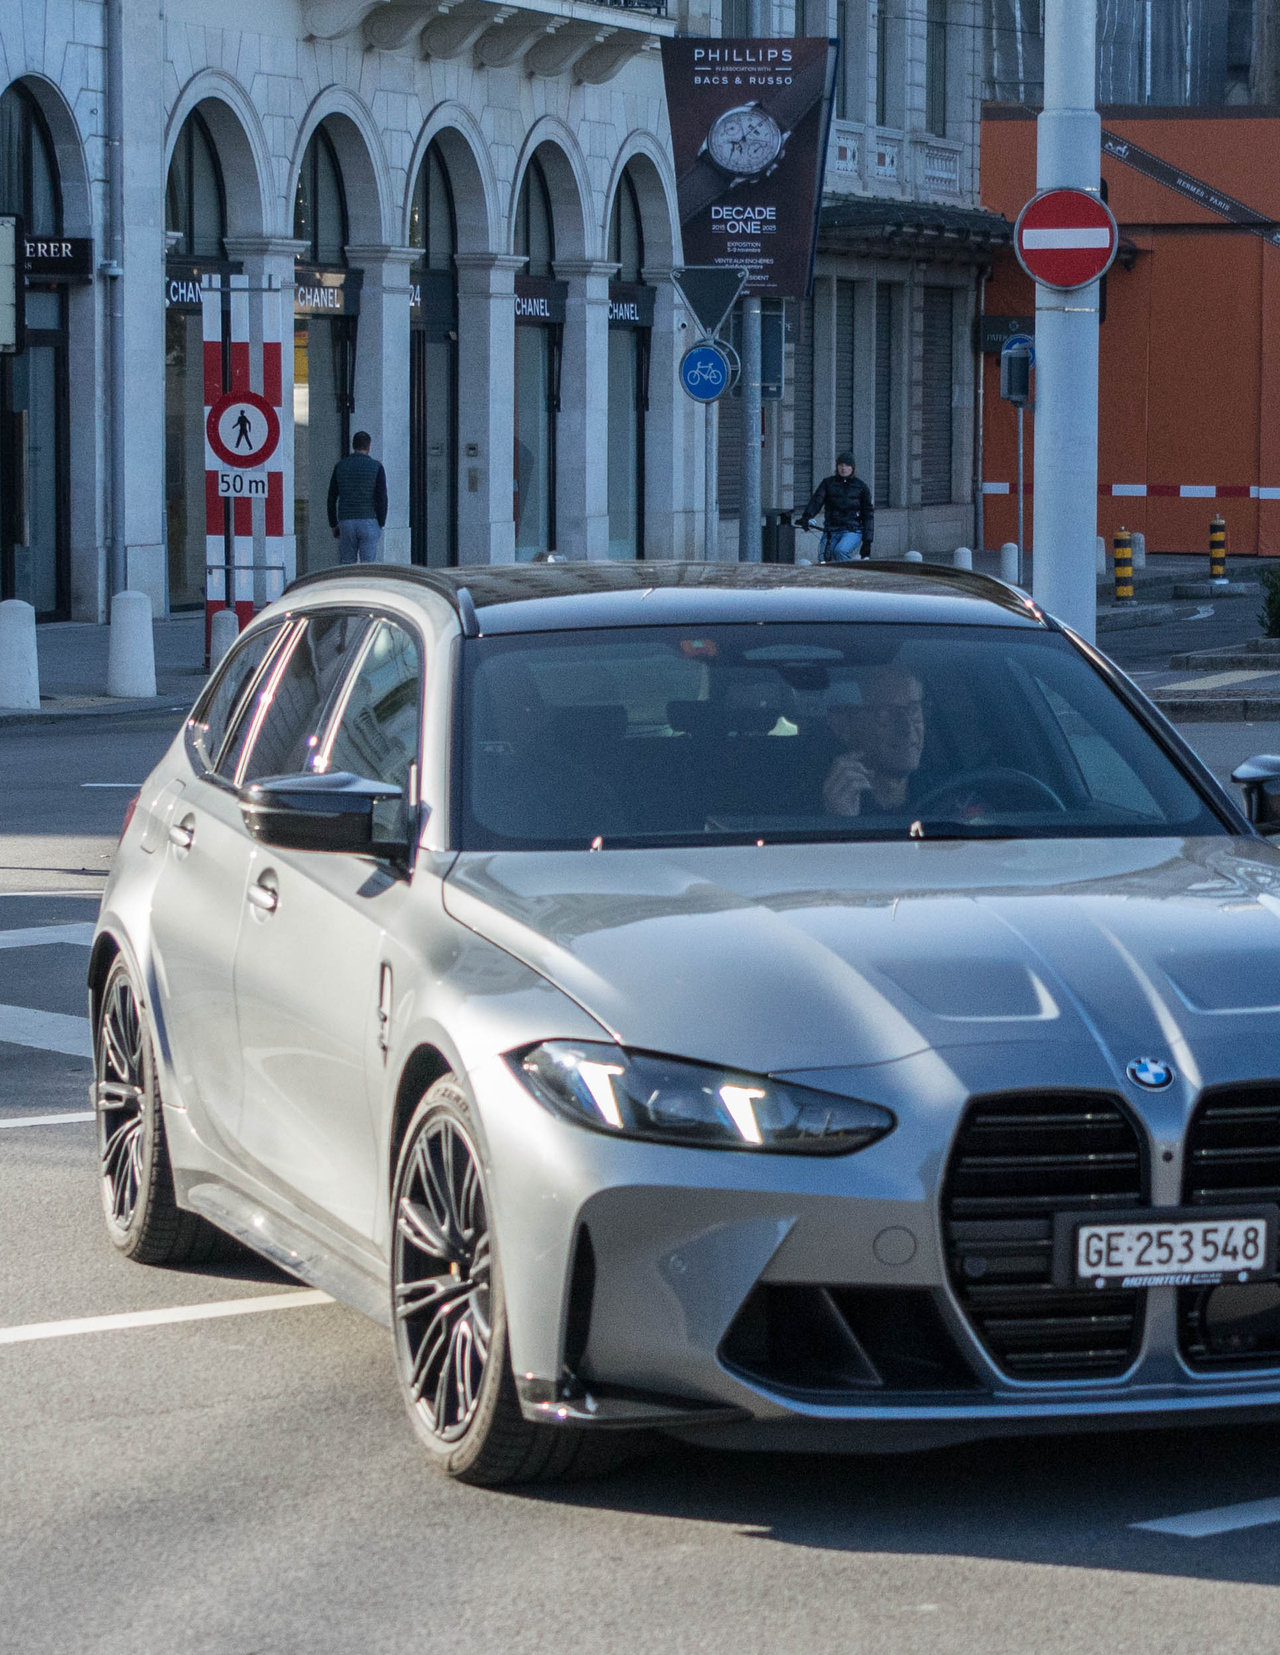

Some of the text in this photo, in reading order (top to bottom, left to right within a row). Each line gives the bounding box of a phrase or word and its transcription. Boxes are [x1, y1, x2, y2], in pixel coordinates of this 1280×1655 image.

[694, 49, 793, 62] PHILLIPS
[694, 76, 793, 85] BACS & RUSSO
[711, 206, 776, 220] DECADE
[727, 220, 761, 234] ONE
[297, 287, 341, 308] CHANEL
[408, 285, 421, 306] 24
[515, 298, 550, 317] CHANEL
[608, 302, 640, 321] CHANEL
[220, 473, 266, 494] 50 m
